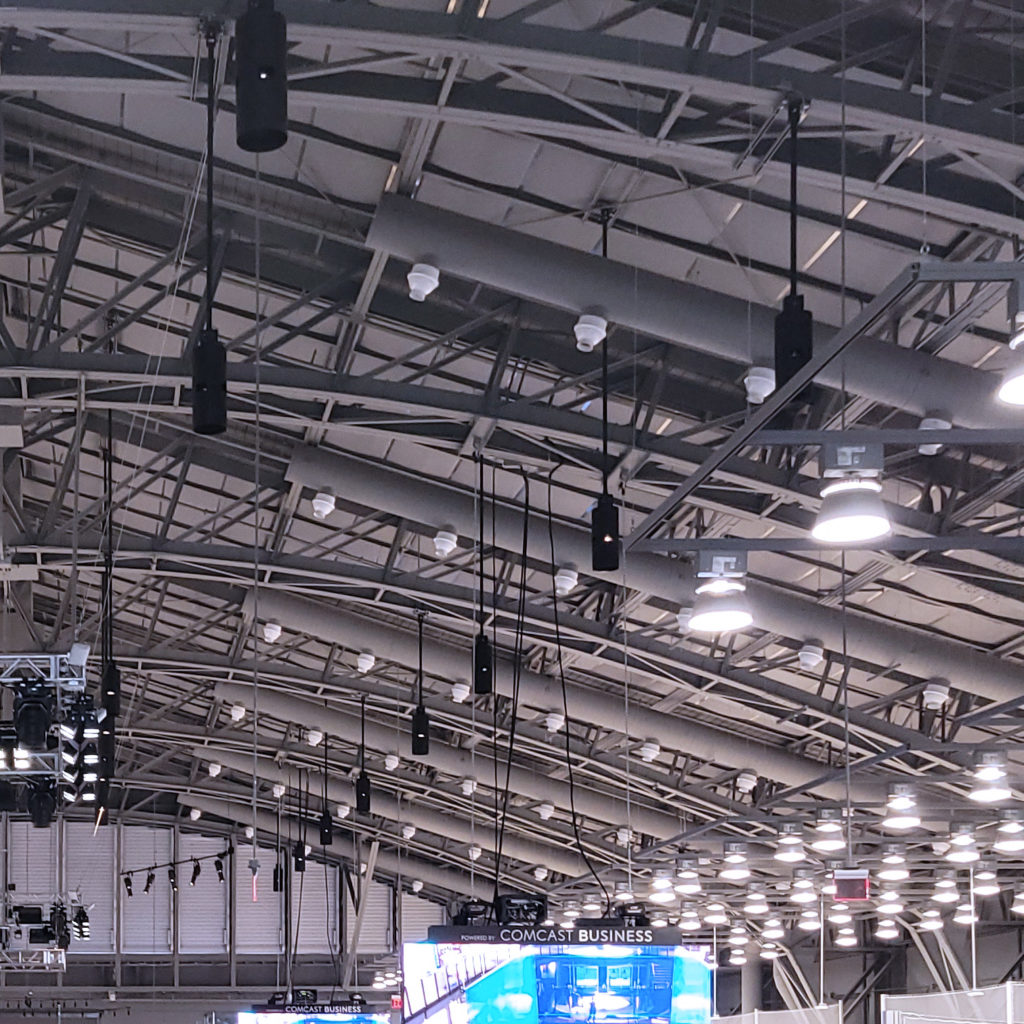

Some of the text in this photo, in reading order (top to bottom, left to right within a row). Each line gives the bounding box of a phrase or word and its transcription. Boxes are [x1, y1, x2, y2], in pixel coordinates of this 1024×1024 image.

[500, 929, 574, 942] COMCAST
[578, 929, 653, 943] BUSINESS
[285, 1005, 362, 1013] COMCAST BUSINESS
